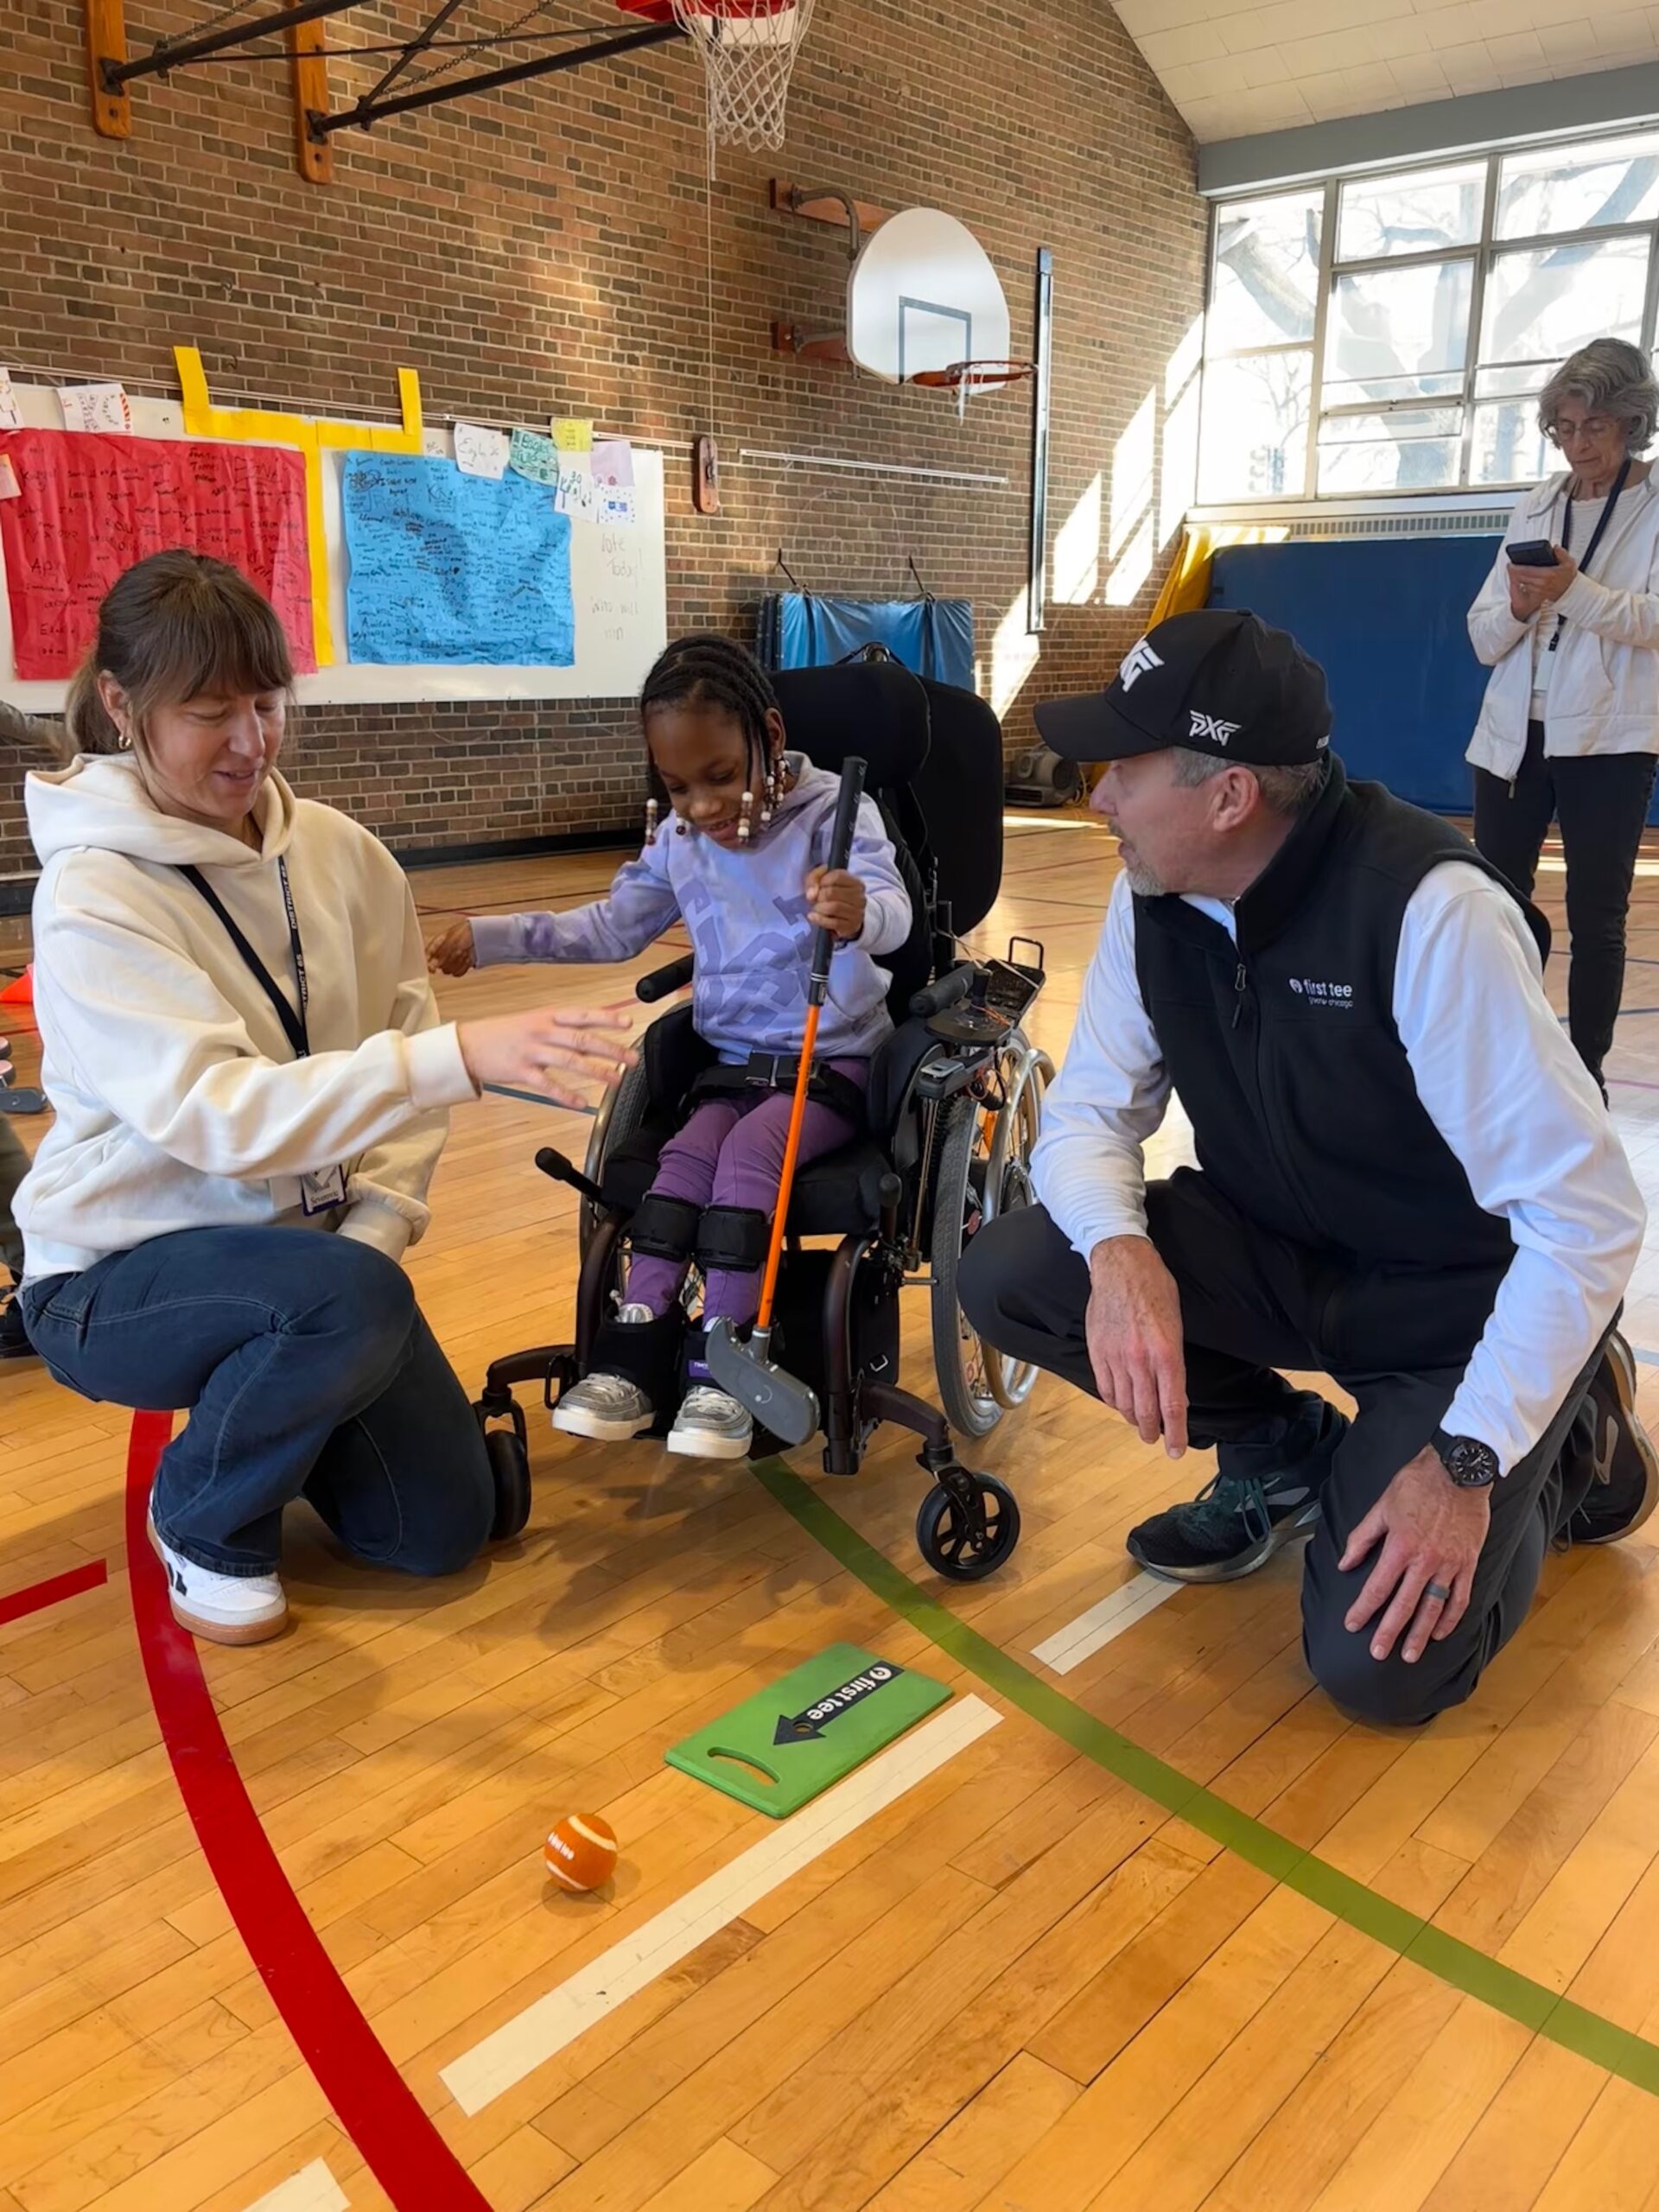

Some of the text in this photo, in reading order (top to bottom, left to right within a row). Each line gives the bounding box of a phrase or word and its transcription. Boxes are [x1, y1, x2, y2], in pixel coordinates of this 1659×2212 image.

[1189, 709, 1242, 747] PXG
[1303, 979, 1352, 997] first tee
[806, 1676, 876, 1720] first tee
